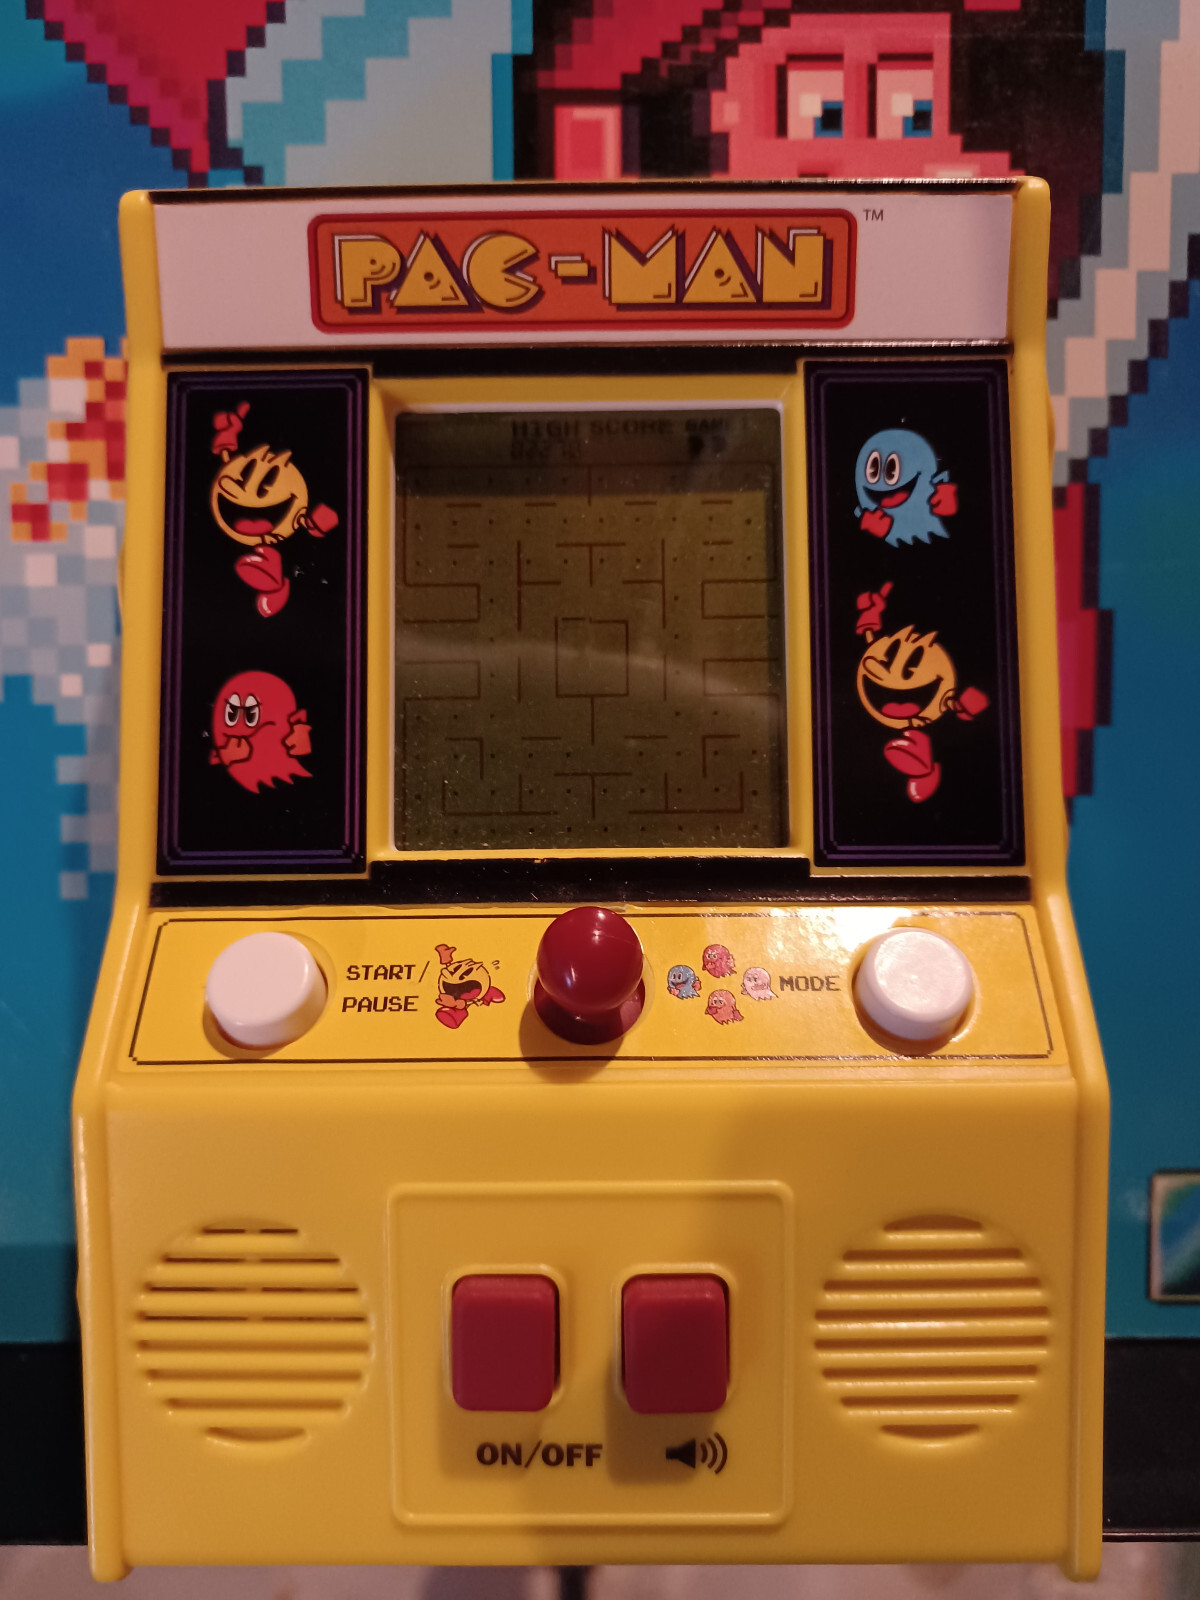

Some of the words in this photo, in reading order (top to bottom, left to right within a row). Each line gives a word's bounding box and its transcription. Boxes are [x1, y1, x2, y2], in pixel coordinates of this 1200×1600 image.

[863, 208, 885, 222] TM
[332, 224, 834, 315] PAC-MAN
[512, 418, 579, 437] HIGH
[590, 417, 674, 435] SCORE
[780, 976, 841, 992] MODE
[342, 996, 419, 1013] PAUSE
[476, 1440, 603, 1469] ON/OFF
